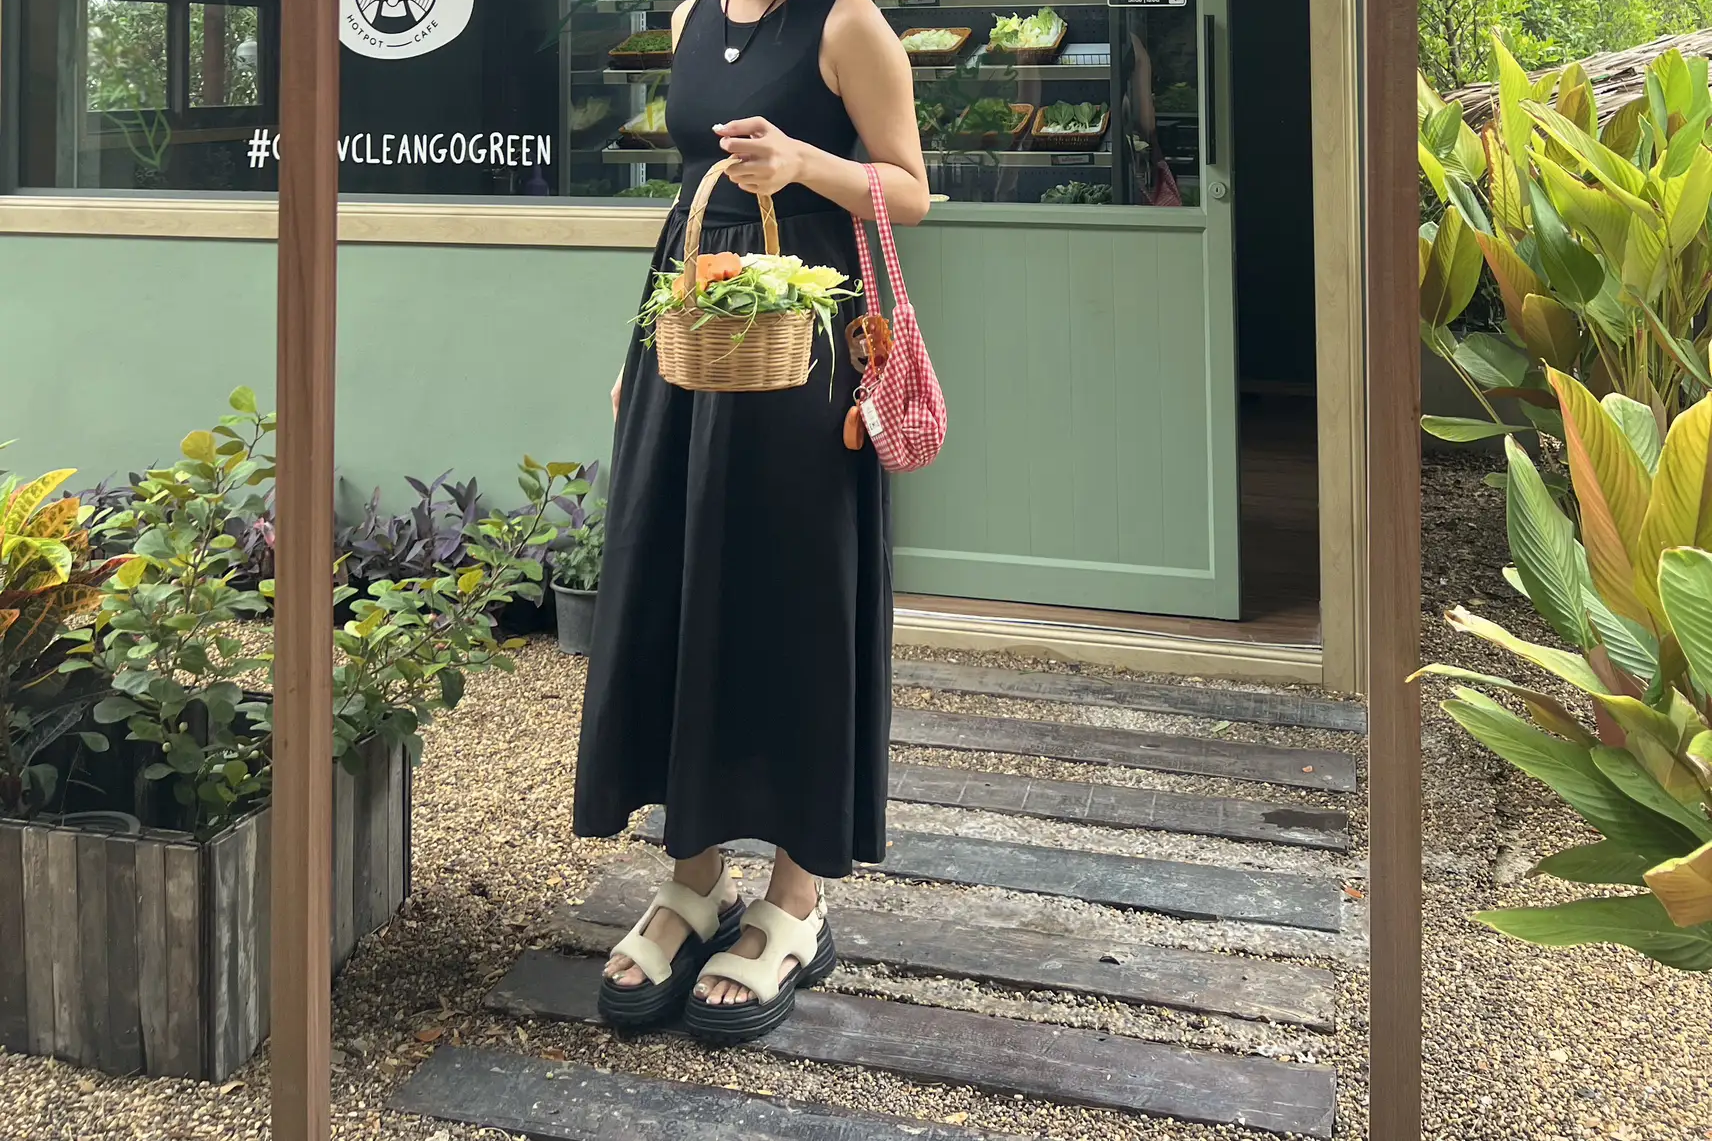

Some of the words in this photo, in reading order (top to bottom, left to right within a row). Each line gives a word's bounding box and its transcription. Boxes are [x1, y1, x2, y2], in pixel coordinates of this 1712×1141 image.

[346, 14, 384, 49] HOTPOT
[414, 19, 439, 43] CAFE
[247, 128, 551, 169] #CLEANGOGREEN
